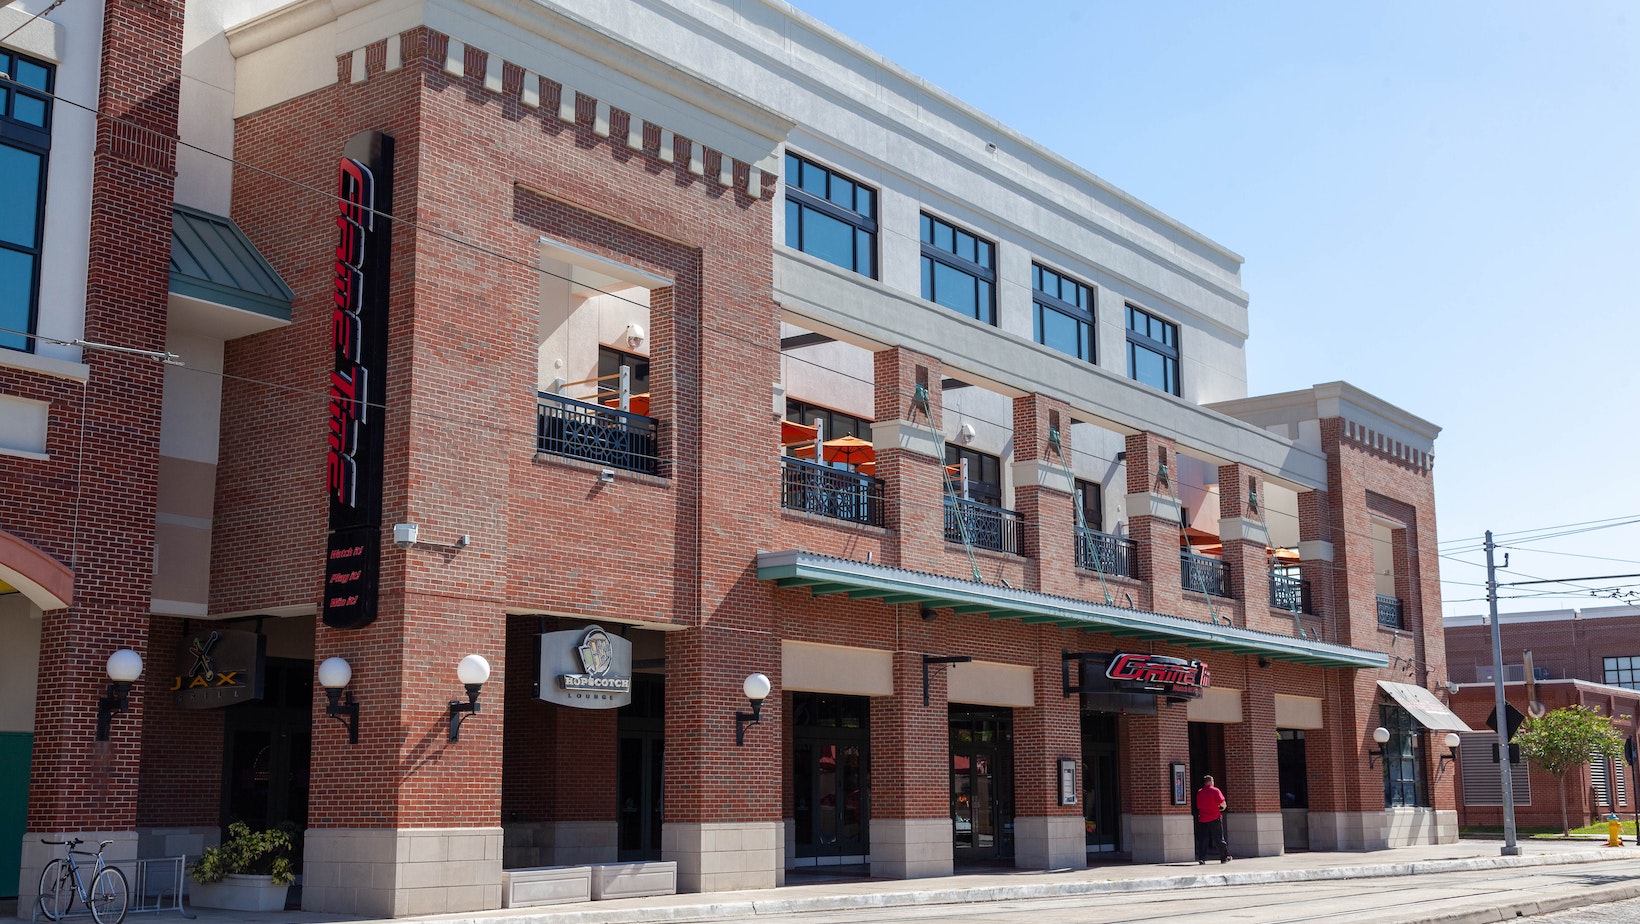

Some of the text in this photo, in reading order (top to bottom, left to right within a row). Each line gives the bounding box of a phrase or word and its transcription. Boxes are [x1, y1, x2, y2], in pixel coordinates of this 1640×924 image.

[330, 547, 353, 559] Watch
[329, 573, 350, 584] Play
[170, 672, 237, 691] JAX
[565, 677, 629, 687] HOPSCOTCH
